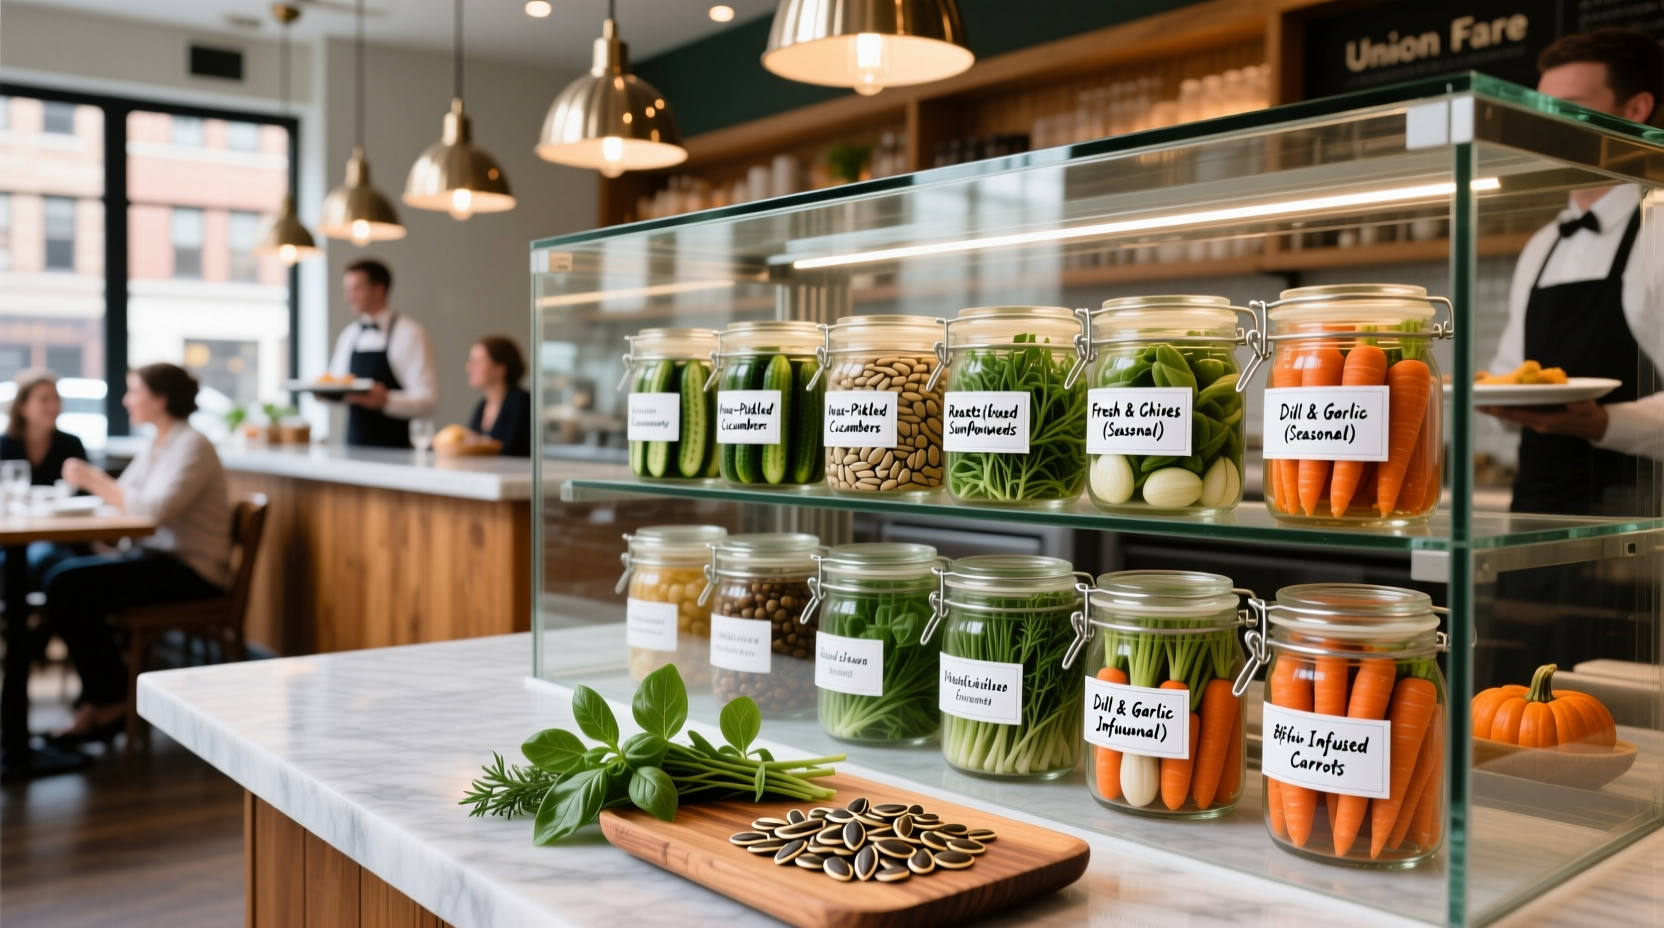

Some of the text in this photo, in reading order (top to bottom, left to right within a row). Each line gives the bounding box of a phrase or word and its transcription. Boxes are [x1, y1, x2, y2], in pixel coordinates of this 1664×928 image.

[1345, 31, 1440, 73] Union
[1450, 13, 1529, 52] Fare
[1125, 402, 1135, 418] &
[1279, 402, 1368, 421] Dill & Garlic
[1284, 423, 1356, 445] (Seasonal)
[1093, 693, 1174, 720] Dill & Garlic
[1307, 730, 1370, 757] Infused
[1290, 750, 1345, 777] Carrots
